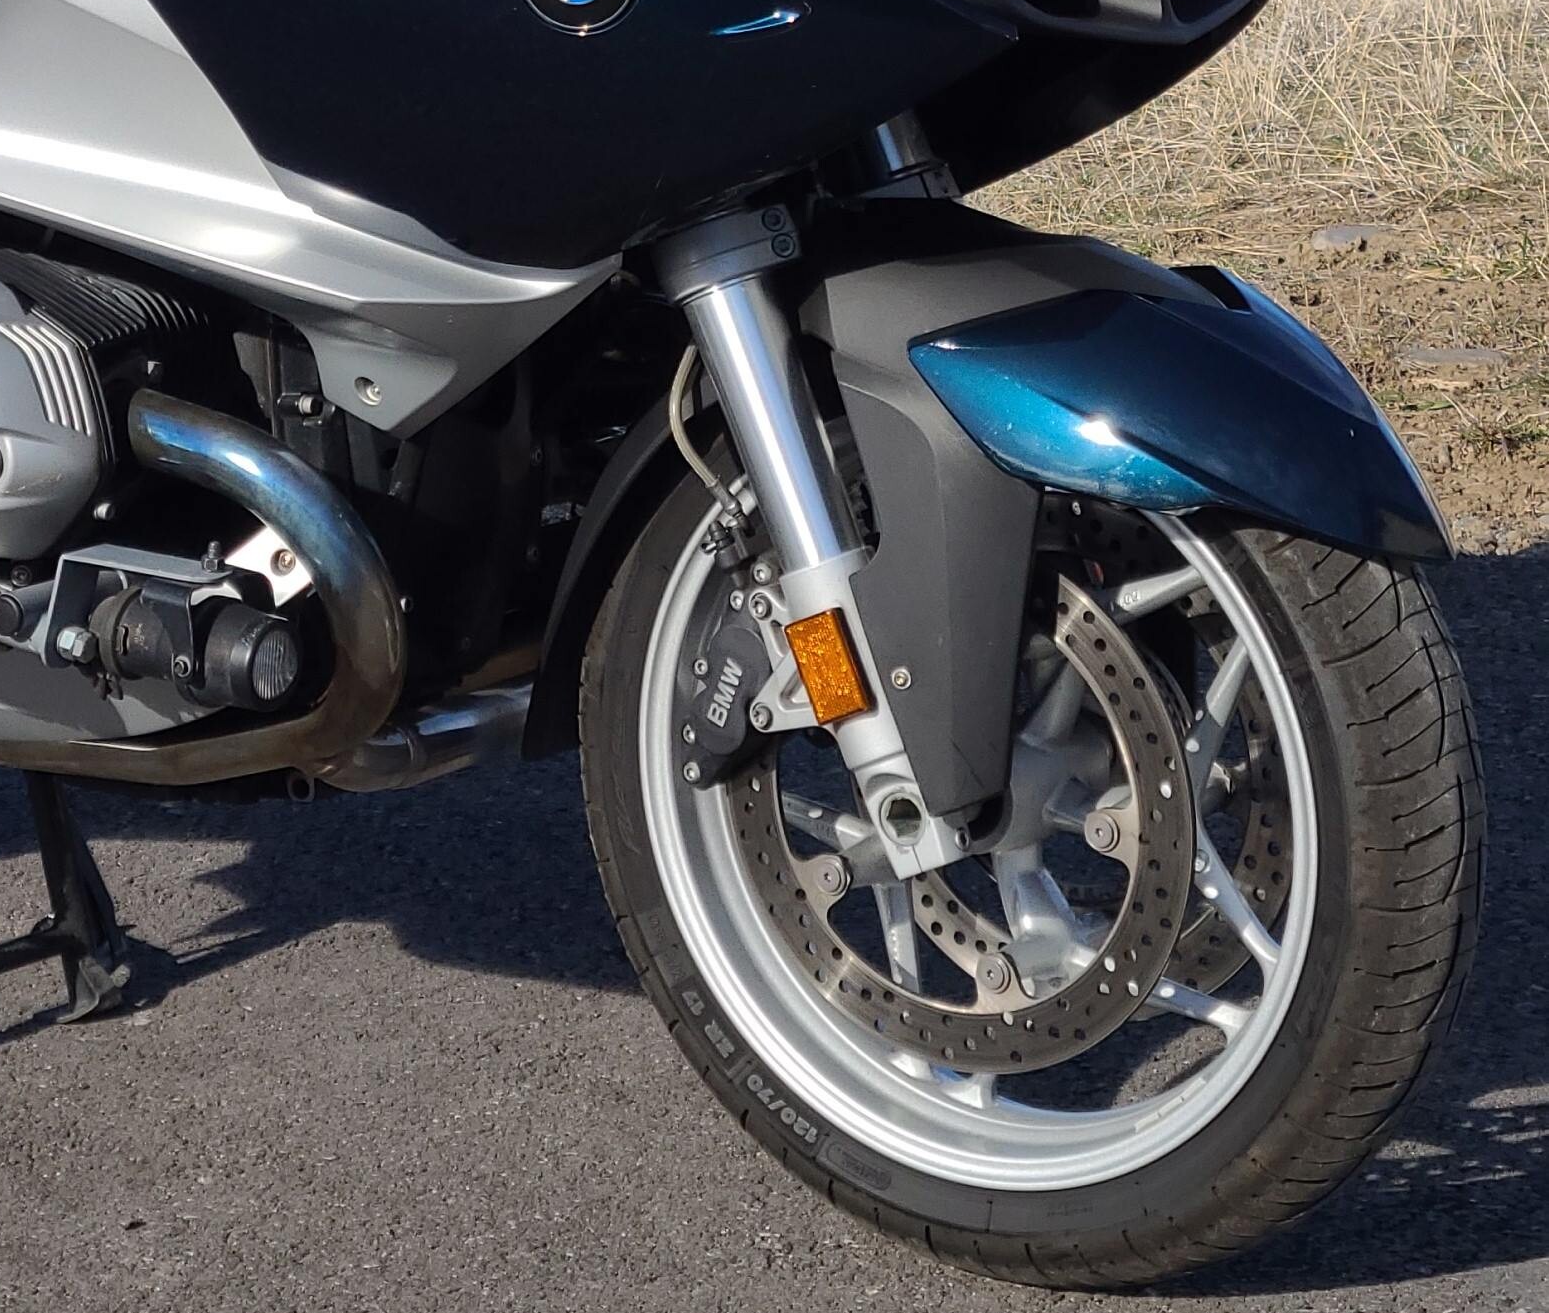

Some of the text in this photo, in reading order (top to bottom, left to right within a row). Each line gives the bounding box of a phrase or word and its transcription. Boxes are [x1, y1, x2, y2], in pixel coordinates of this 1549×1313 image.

[707, 657, 743, 728] BMW
[681, 991, 705, 1016] 17
[747, 1074, 819, 1144] 120/70
